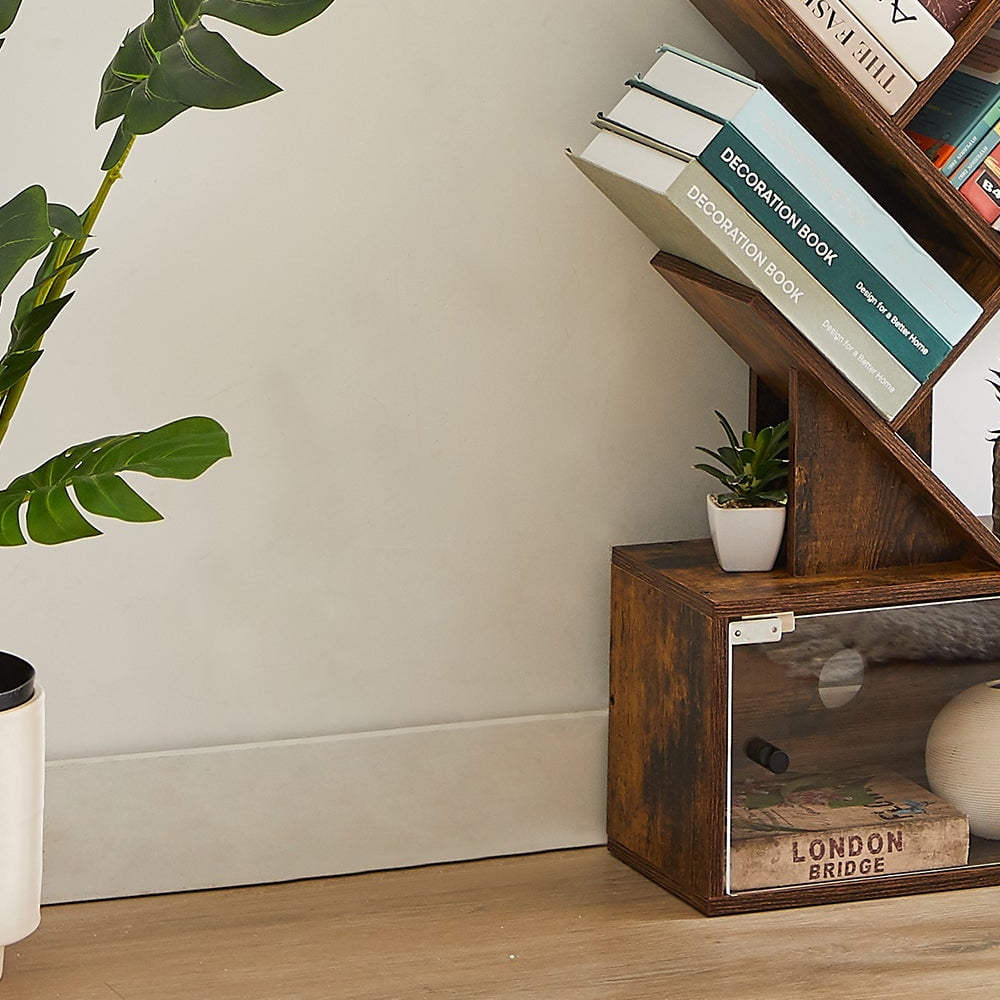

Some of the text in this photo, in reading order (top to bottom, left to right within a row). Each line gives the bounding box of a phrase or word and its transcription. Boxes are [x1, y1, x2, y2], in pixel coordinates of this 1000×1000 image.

[850, 39, 901, 95] THE
[685, 183, 805, 304] DECORATION BOOK
[718, 145, 802, 231] DECORATION
[796, 222, 839, 267] BOOK
[820, 318, 896, 394] Design for a Better Home
[854, 280, 930, 356] Design for a Better Home
[792, 830, 903, 863] LONDON
[809, 856, 885, 880] BRIDGE
